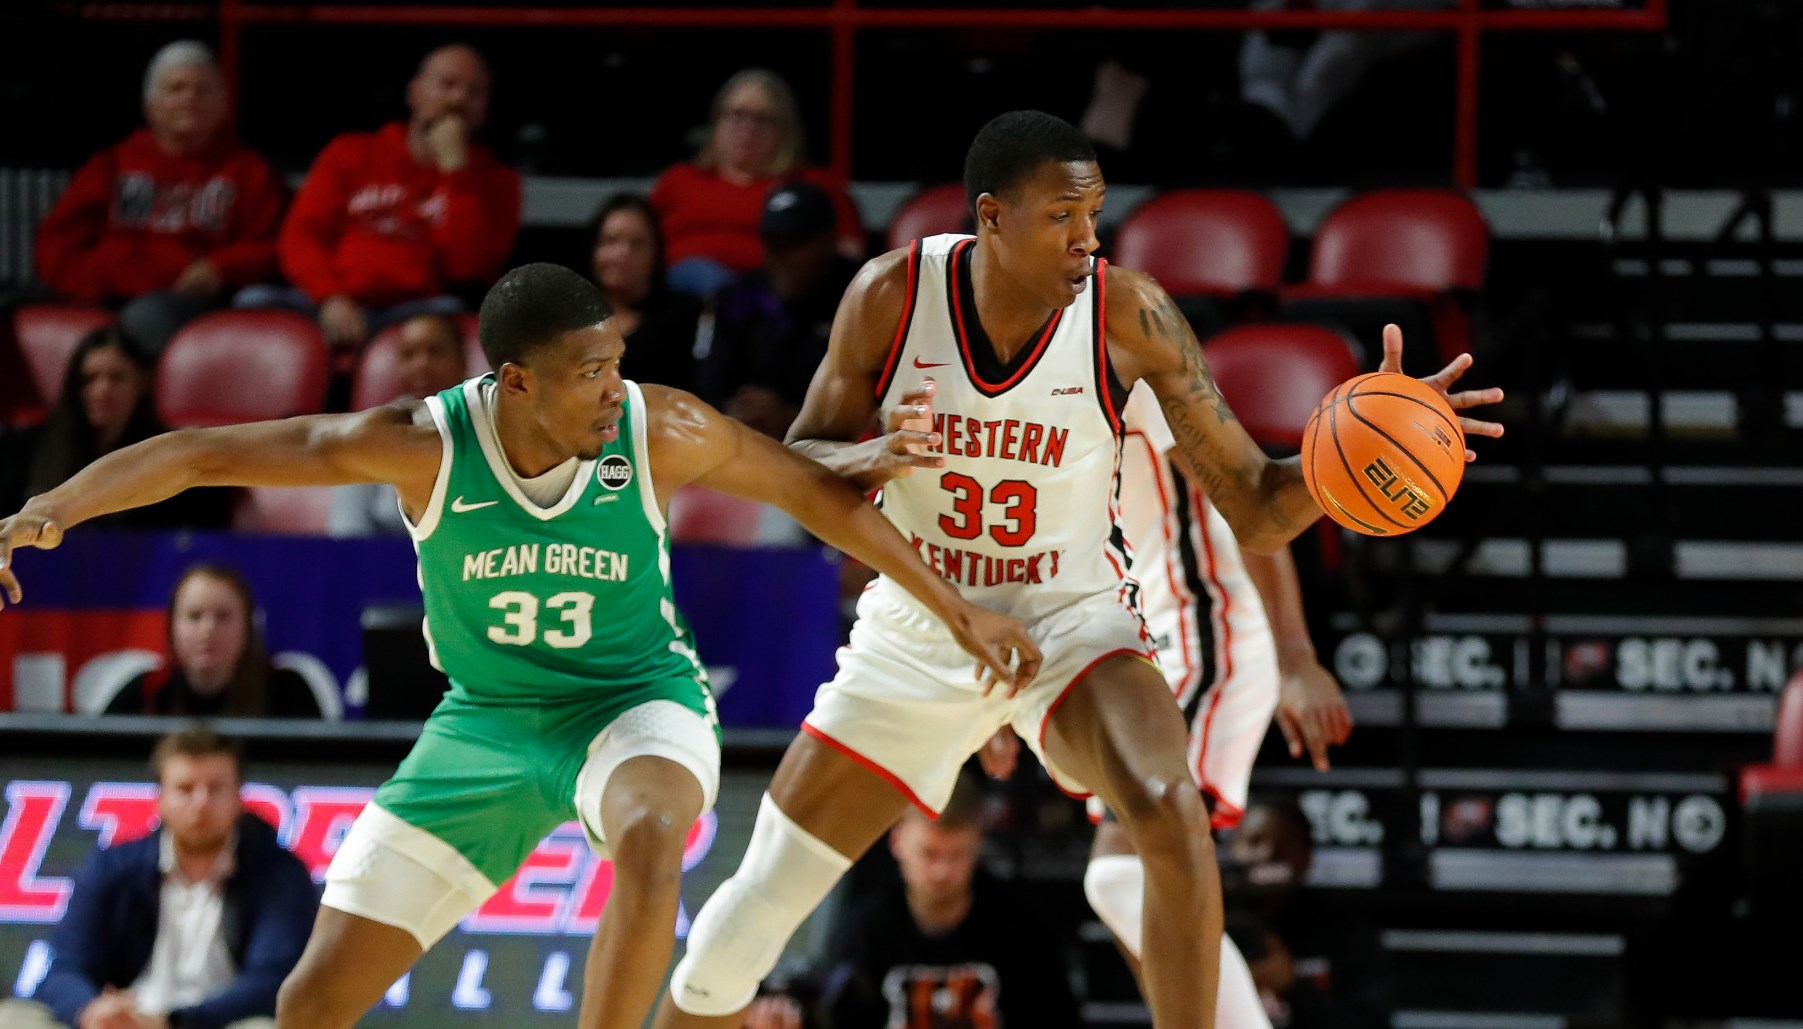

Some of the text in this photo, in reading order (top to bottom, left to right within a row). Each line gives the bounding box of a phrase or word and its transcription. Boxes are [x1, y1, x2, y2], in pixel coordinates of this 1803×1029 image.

[601, 464, 629, 480] HAGG
[1362, 457, 1430, 521] ELITE
[937, 471, 1037, 547] 33
[462, 543, 629, 582] MEAN GREEN
[487, 590, 596, 649] 33
[1615, 636, 1734, 691] SEC.
[1495, 794, 1617, 850] SEC.
